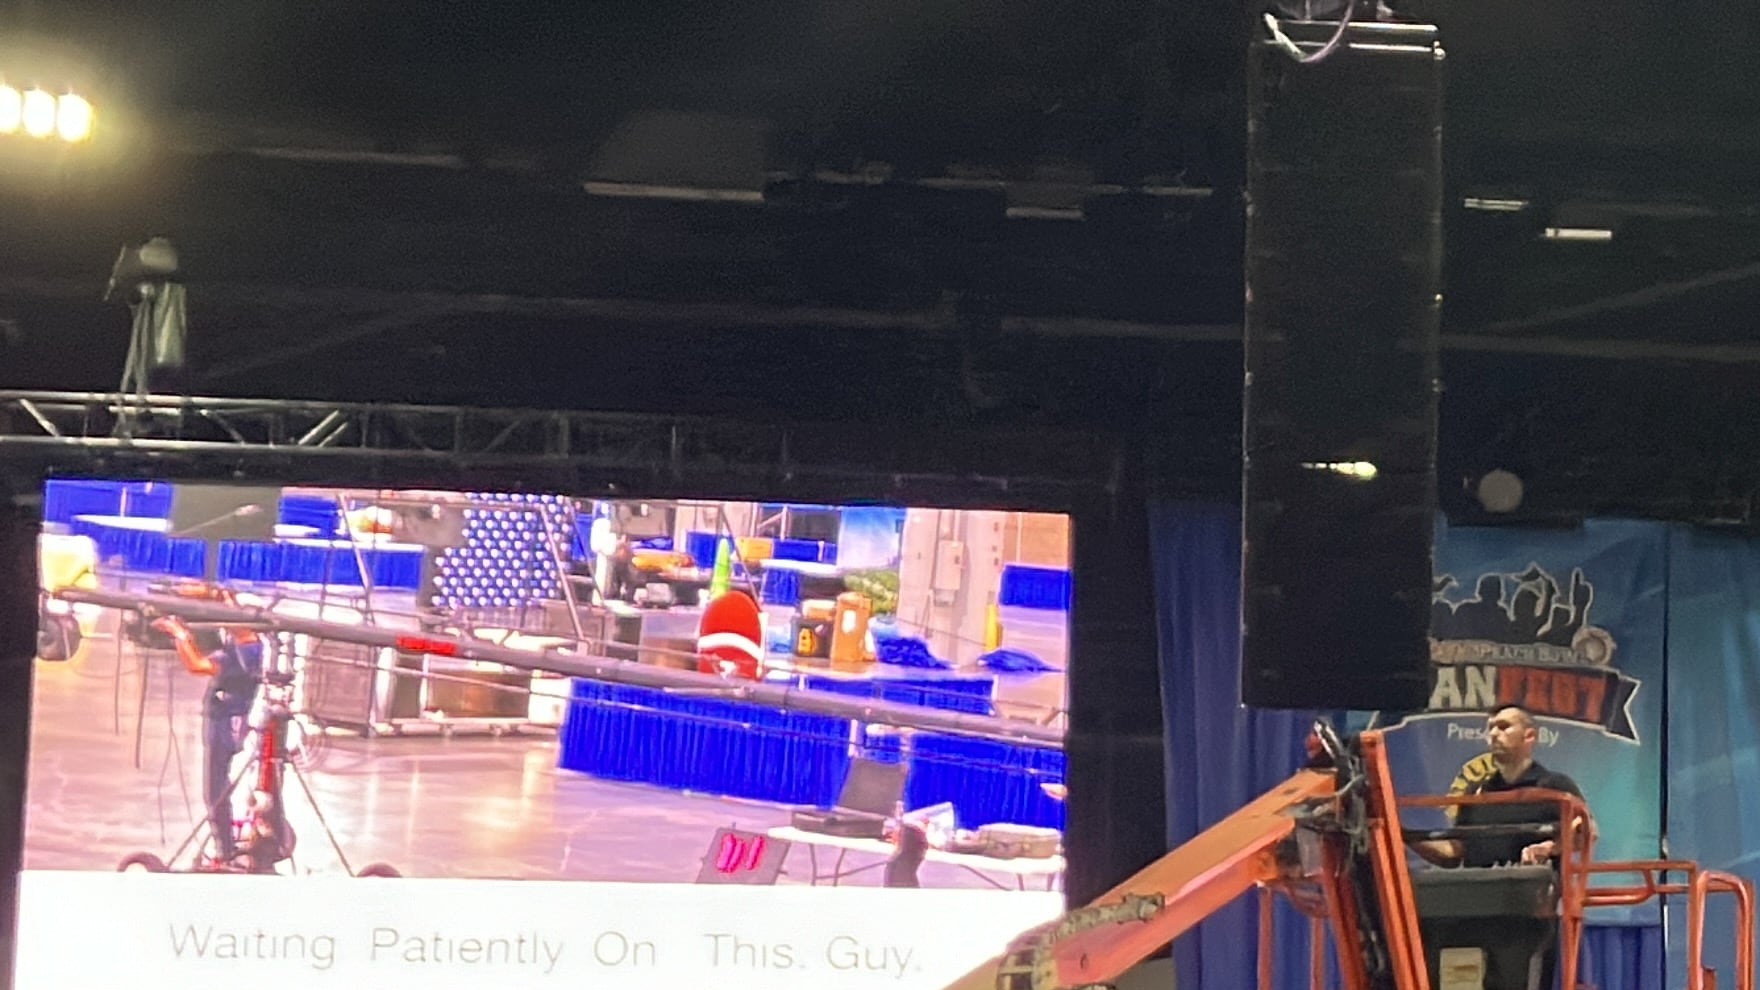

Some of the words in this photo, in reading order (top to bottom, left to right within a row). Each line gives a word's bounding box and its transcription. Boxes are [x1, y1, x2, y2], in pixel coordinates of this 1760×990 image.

[1428, 666, 1606, 723] ANFEST
[169, 922, 336, 970] Waiting
[370, 926, 565, 975] Patiently
[593, 930, 657, 968] On
